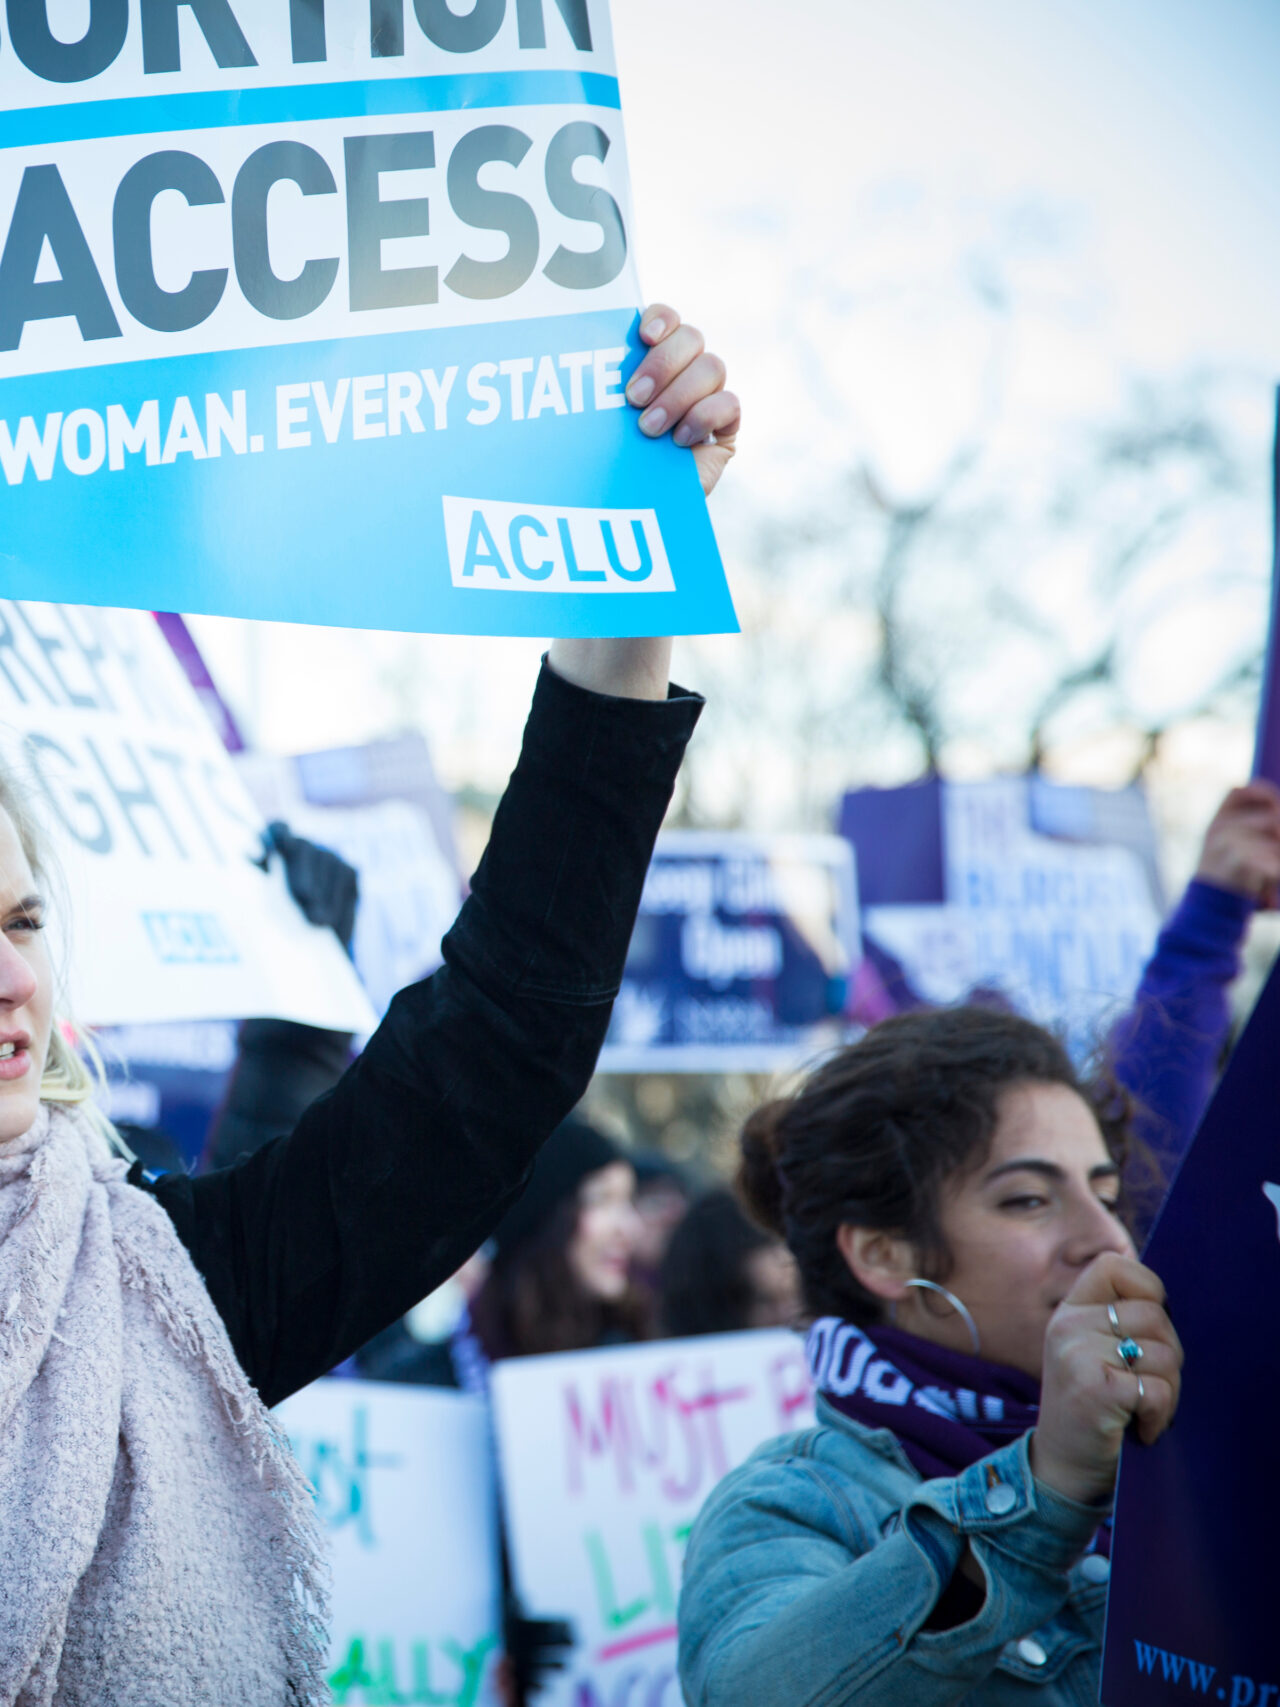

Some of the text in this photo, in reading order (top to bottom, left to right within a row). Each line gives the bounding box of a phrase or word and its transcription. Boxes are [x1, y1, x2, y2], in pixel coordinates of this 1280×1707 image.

[275, 365, 459, 450] EVERY
[466, 346, 626, 425] STATE
[462, 510, 654, 582] ACLU
[1134, 1637, 1280, 1707] www.pr
